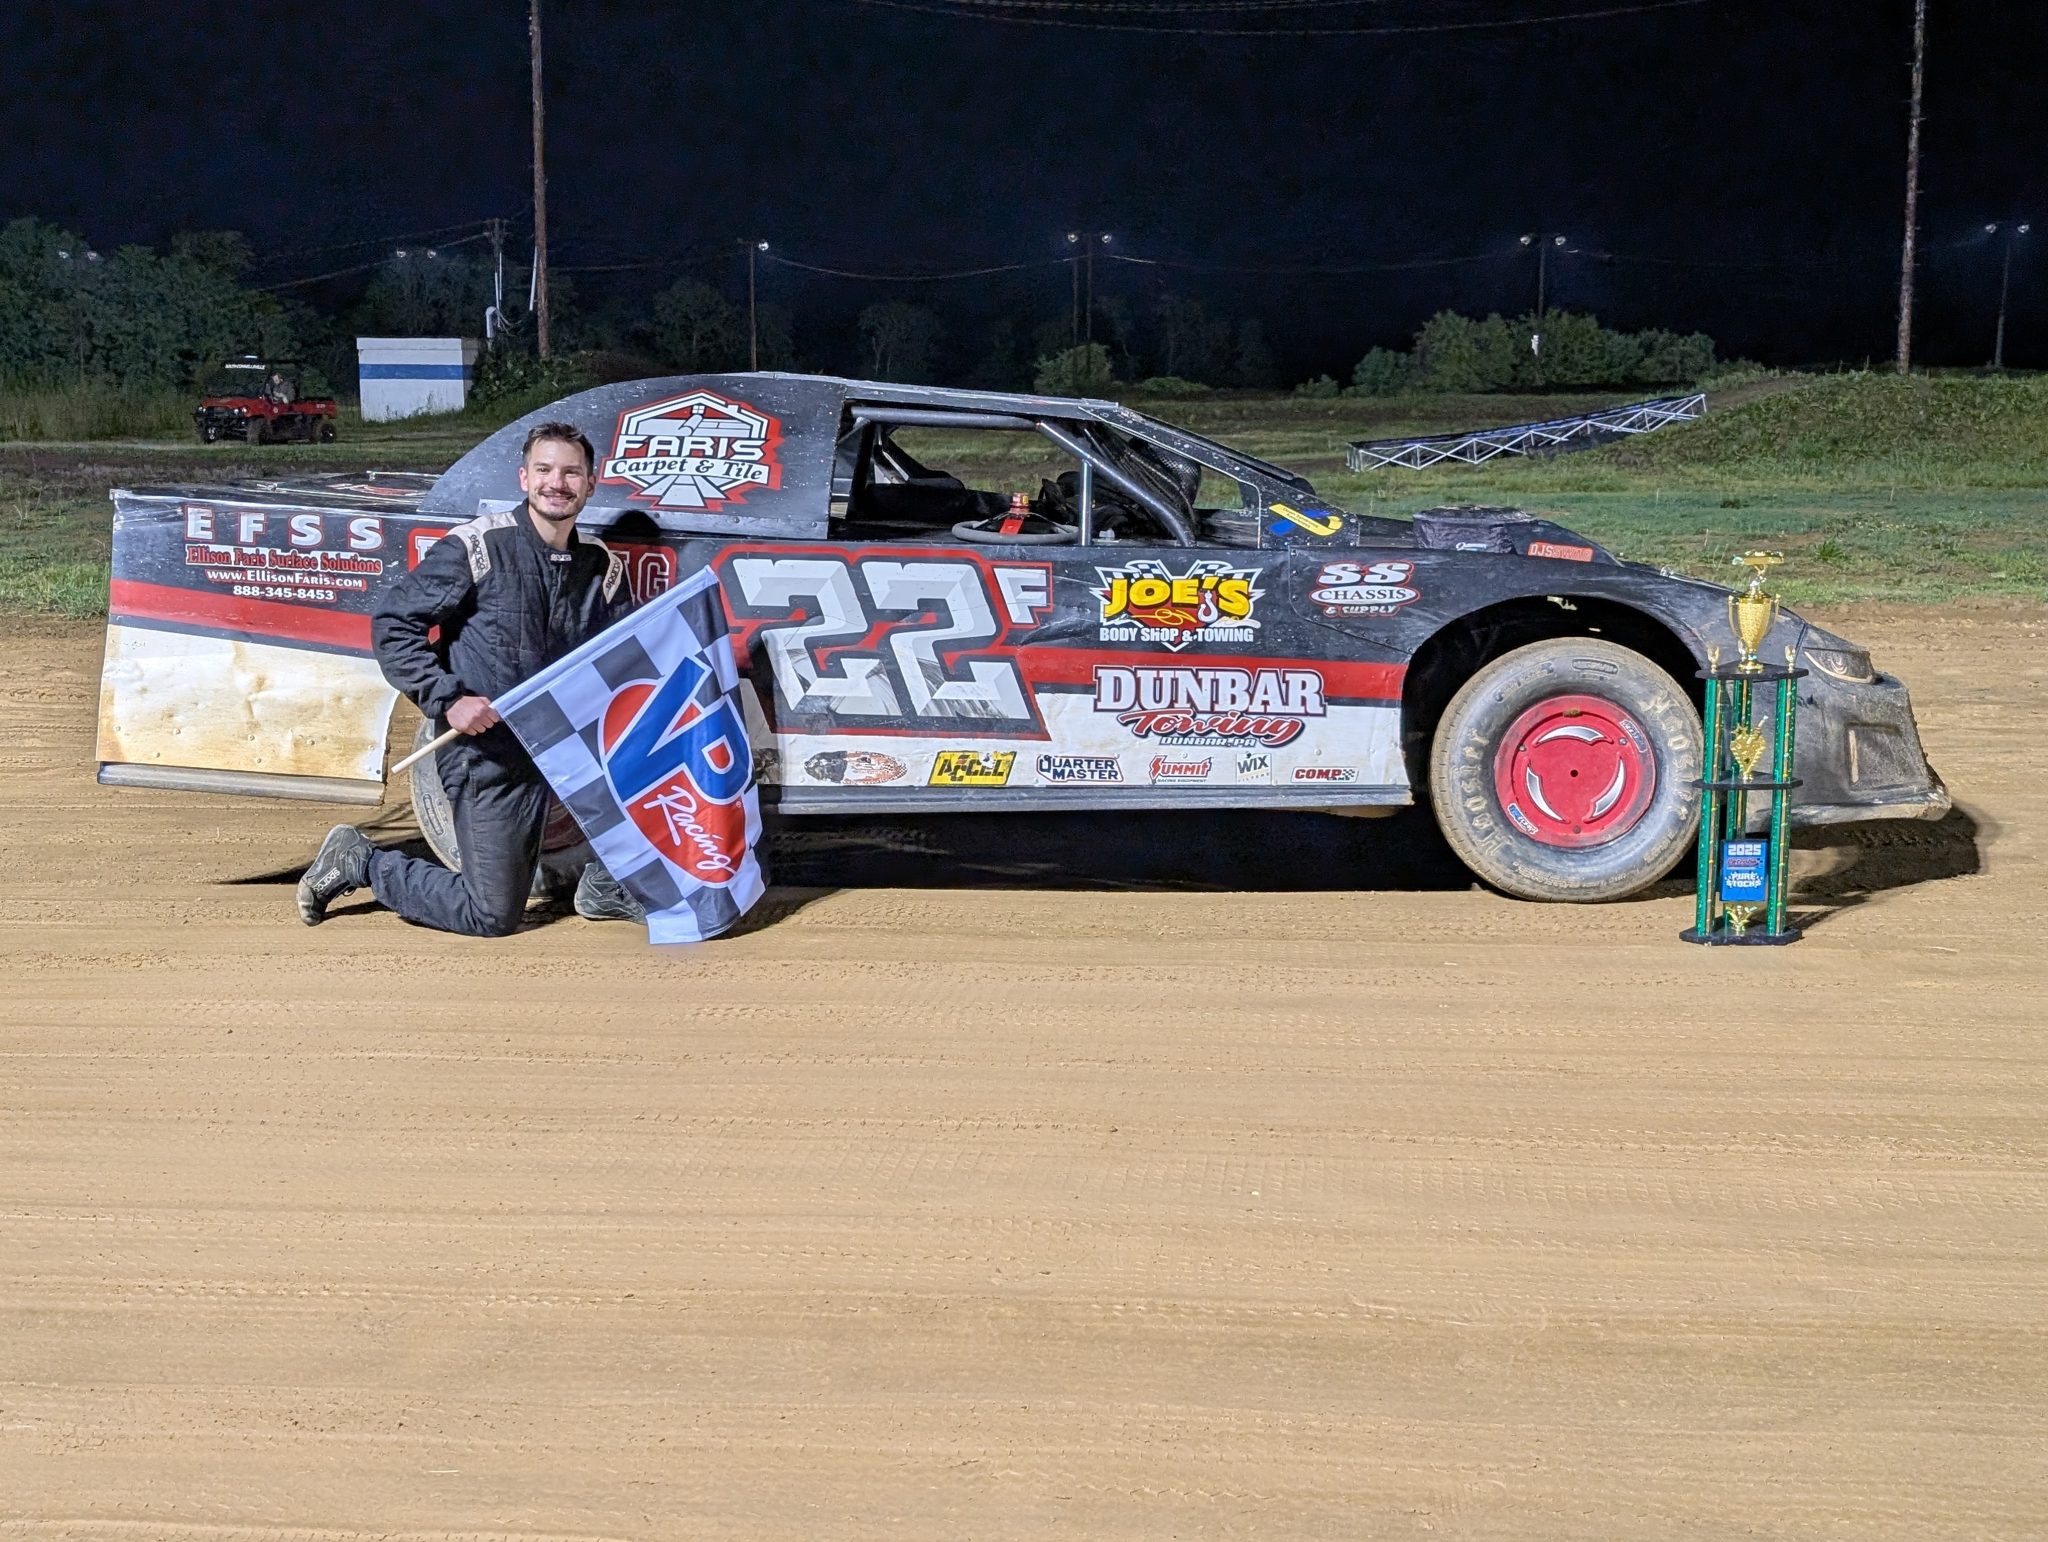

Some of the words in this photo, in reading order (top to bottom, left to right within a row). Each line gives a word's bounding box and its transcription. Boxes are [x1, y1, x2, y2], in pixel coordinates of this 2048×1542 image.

[615, 435, 767, 461] FARIS
[611, 458, 689, 475] Carpet
[695, 462, 714, 473] &
[722, 462, 763, 480] Tile
[187, 547, 231, 563] Ellison
[234, 548, 266, 566] Faris
[269, 549, 317, 569] Surface
[321, 552, 382, 573] Solutions
[233, 585, 334, 600] 888-345-8453
[1104, 576, 1251, 618] JOE'S
[1318, 589, 1407, 600] CHASSIS
[1325, 606, 1337, 614] &
[1342, 604, 1397, 614] SUPPLY
[733, 558, 1031, 719] 22
[993, 567, 1047, 624] F
[1100, 628, 1137, 642] BODY
[1140, 627, 1179, 642] SHOP
[1182, 630, 1193, 642] &
[1196, 628, 1254, 643] TOWING
[1095, 667, 1326, 716] DUNBAR
[604, 656, 751, 803] VP
[1118, 708, 1303, 744] Towing
[937, 755, 1004, 781] ACCEL
[1039, 755, 1115, 773] QUARTER
[1237, 755, 1269, 773] WIX
[1052, 769, 1118, 780] MASTER
[1294, 769, 1342, 779] COMP
[643, 785, 737, 873] Racing
[1727, 843, 1762, 856] 2025
[1725, 879, 1762, 888] STOCKS
[1731, 872, 1757, 880] PURE
